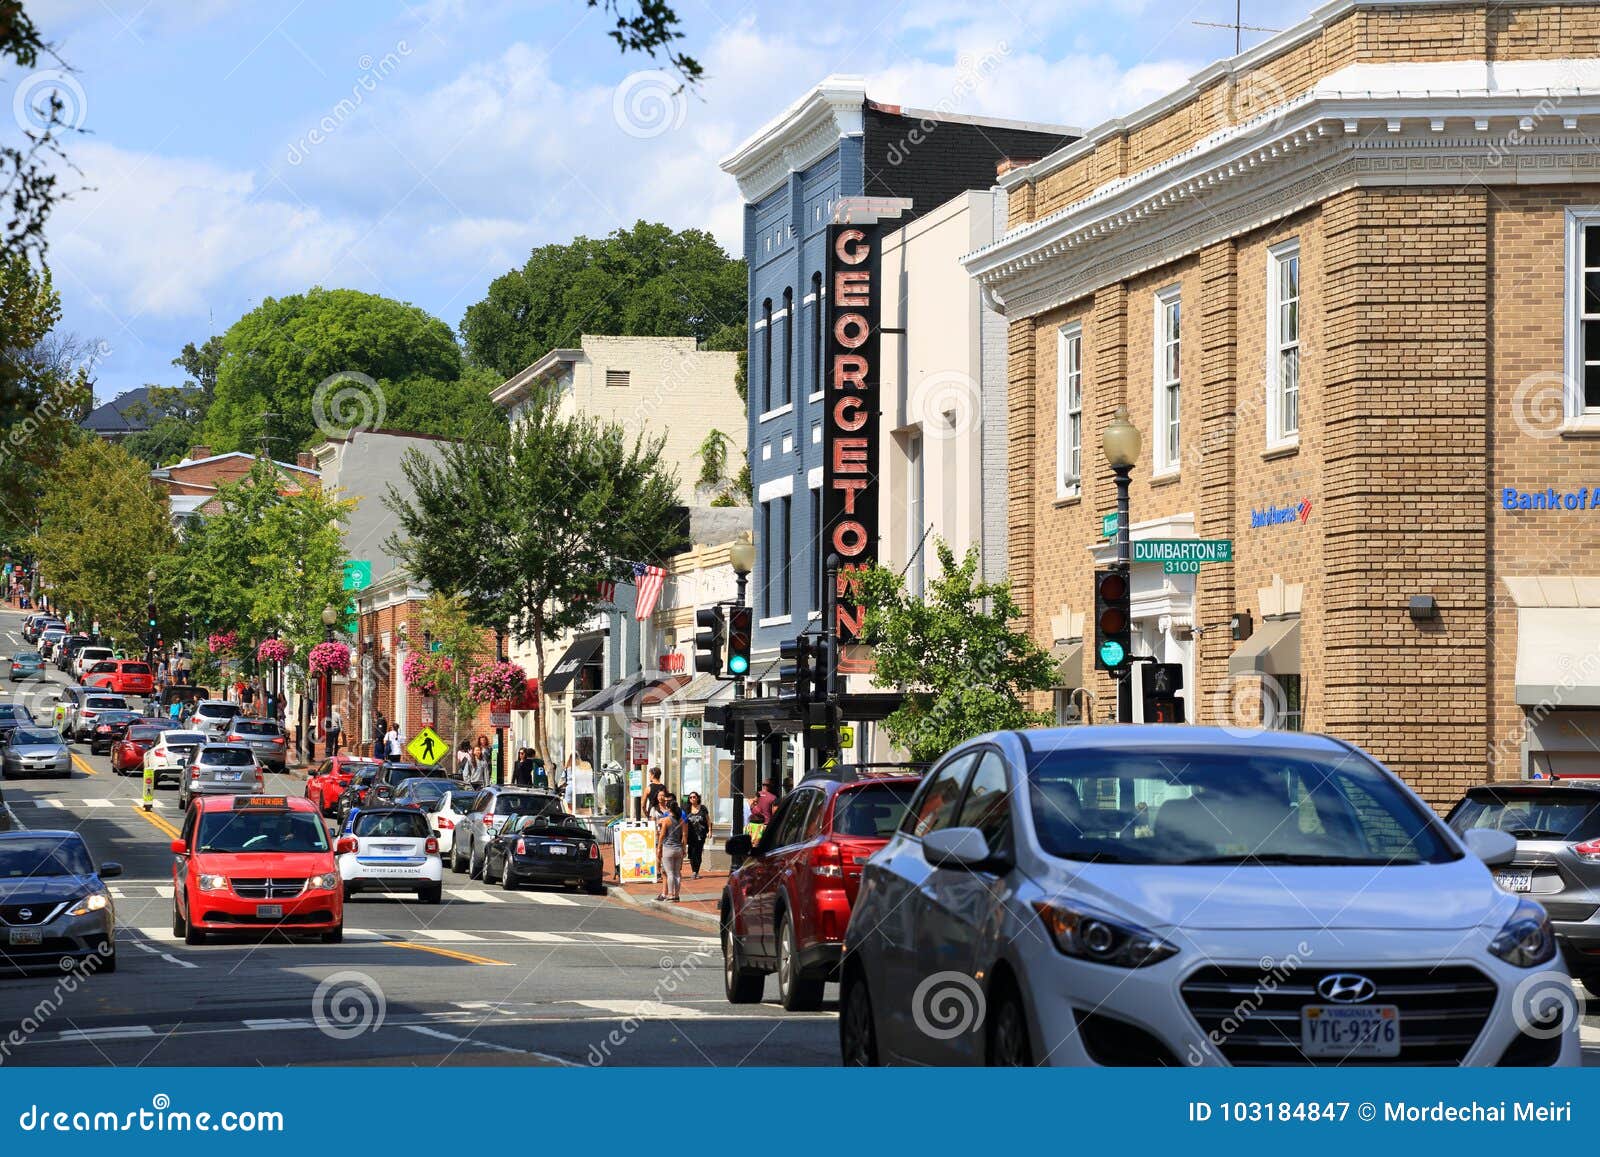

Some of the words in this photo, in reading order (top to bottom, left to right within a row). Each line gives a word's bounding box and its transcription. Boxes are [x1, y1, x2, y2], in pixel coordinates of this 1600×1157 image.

[832, 229, 871, 639] GEORGETOWN
[1502, 487, 1562, 510] Bank
[1563, 487, 1588, 510] of
[1135, 543, 1215, 559] DUMBARTON
[1217, 543, 1228, 551] ST
[1165, 562, 1199, 572] 3100
[1327, 1008, 1374, 1018] VIRGINIA
